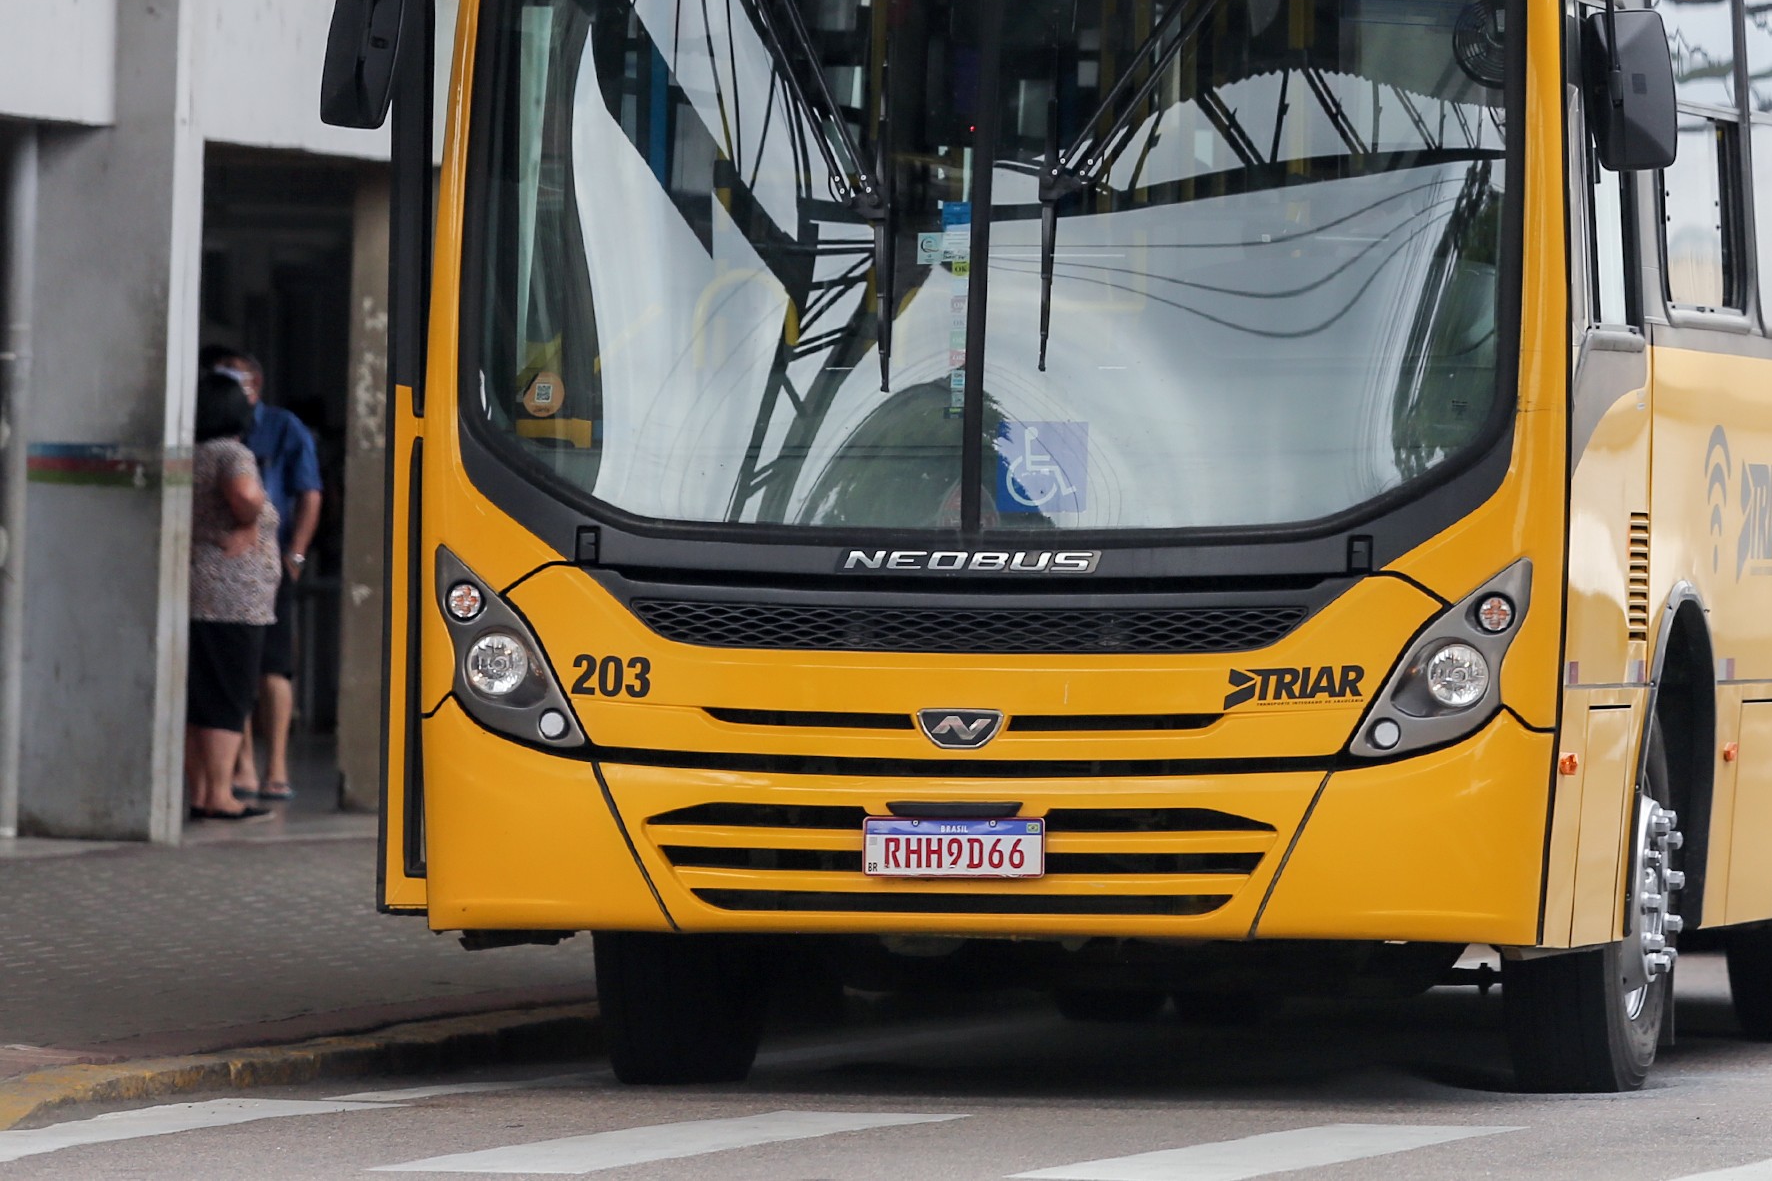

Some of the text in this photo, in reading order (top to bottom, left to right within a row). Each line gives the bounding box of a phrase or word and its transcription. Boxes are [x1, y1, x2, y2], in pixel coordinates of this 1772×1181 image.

[844, 550, 1094, 571] NEOBUS
[571, 653, 651, 698] 203
[1245, 665, 1364, 700] TRIAR
[940, 825, 968, 833] BRASIL
[884, 837, 1025, 869] RHH9D66
[868, 862, 878, 872] BR
